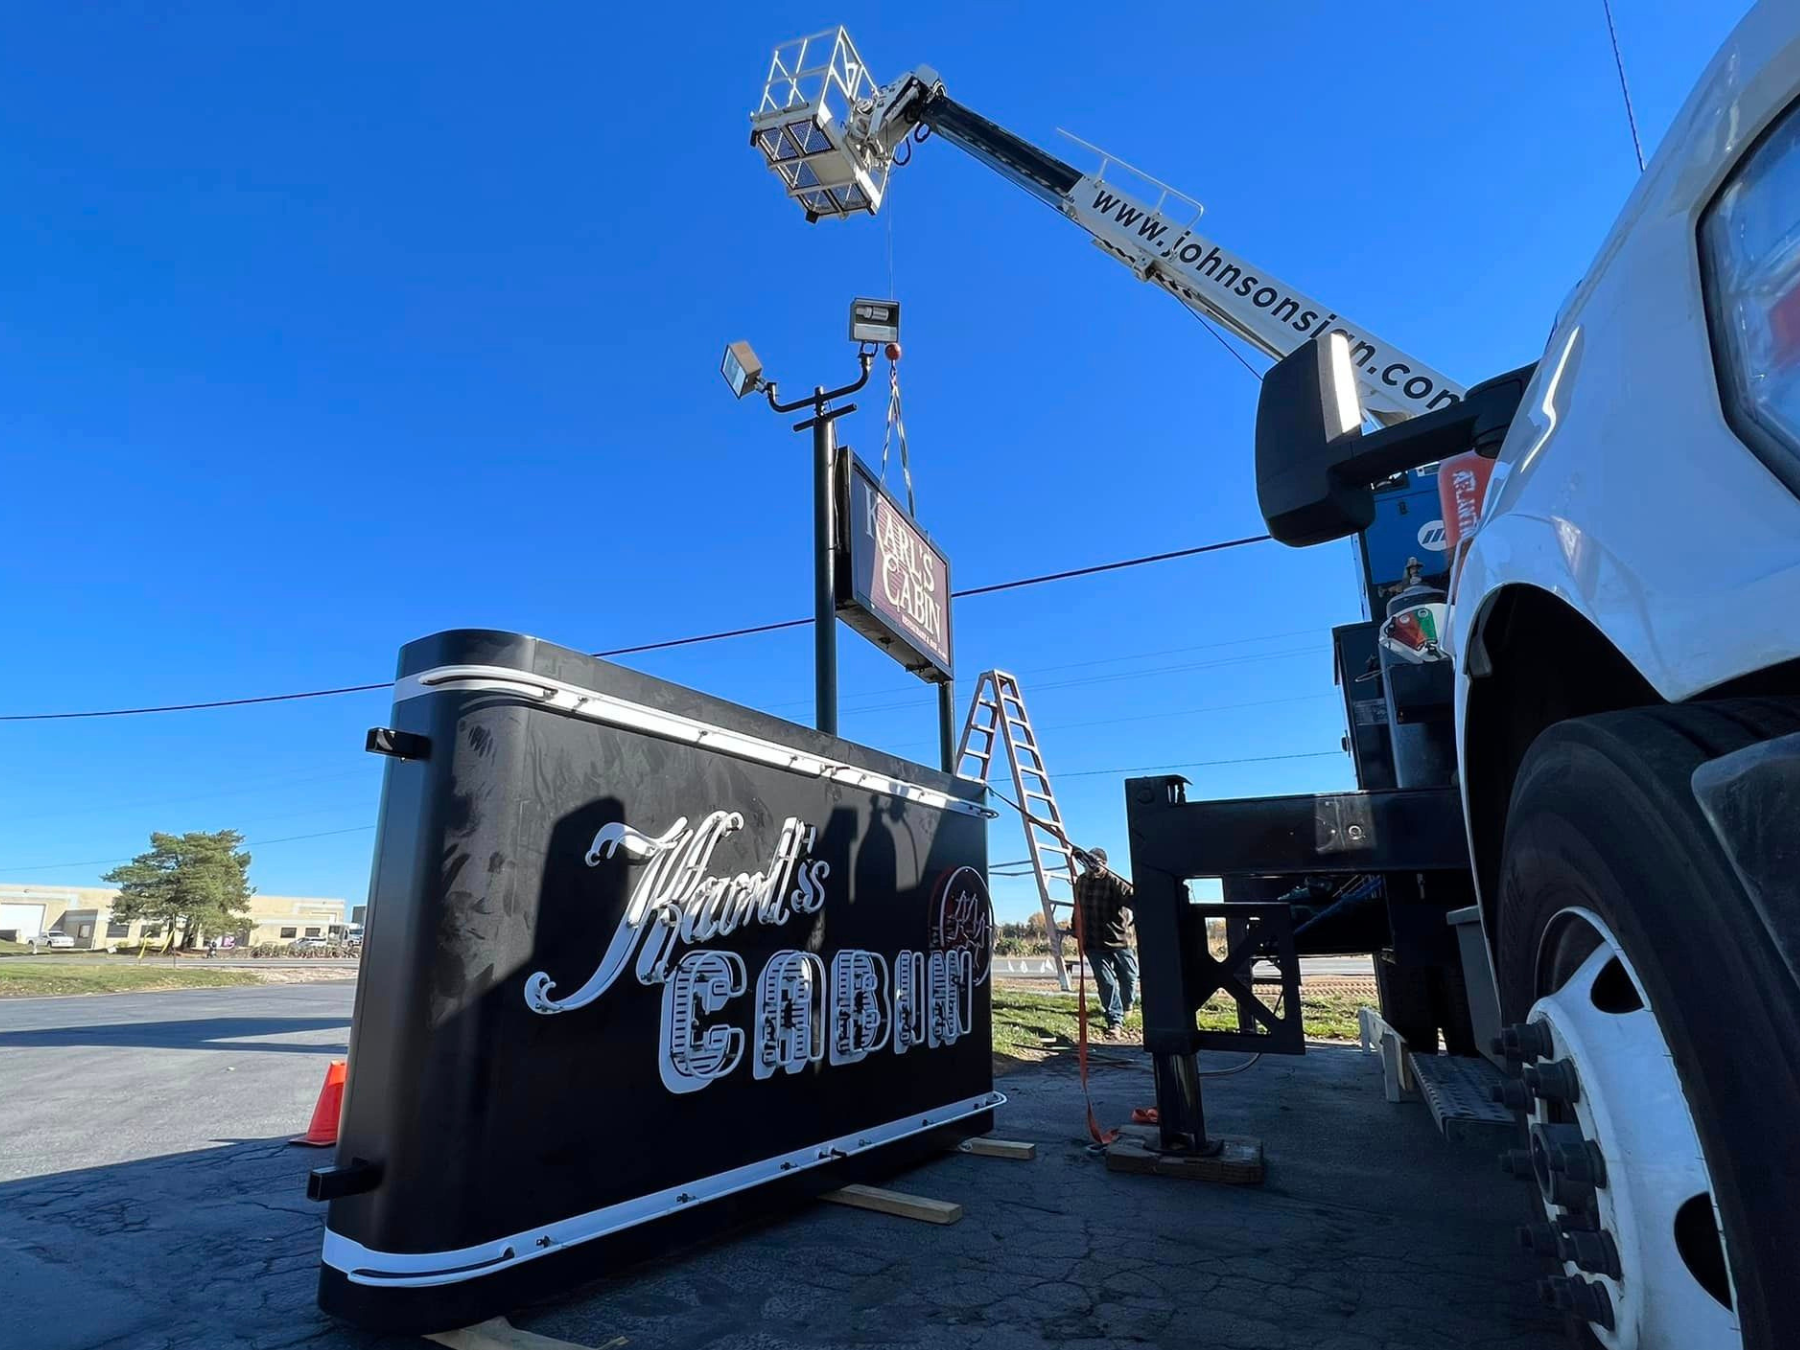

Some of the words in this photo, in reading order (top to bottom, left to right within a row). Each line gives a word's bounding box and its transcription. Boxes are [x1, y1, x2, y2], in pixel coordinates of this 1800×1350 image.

[1093, 190, 1460, 410] www.johnsonsin.co
[864, 483, 935, 592] KARL'S
[882, 553, 941, 643] CABIN
[658, 949, 973, 1094] CABIN
